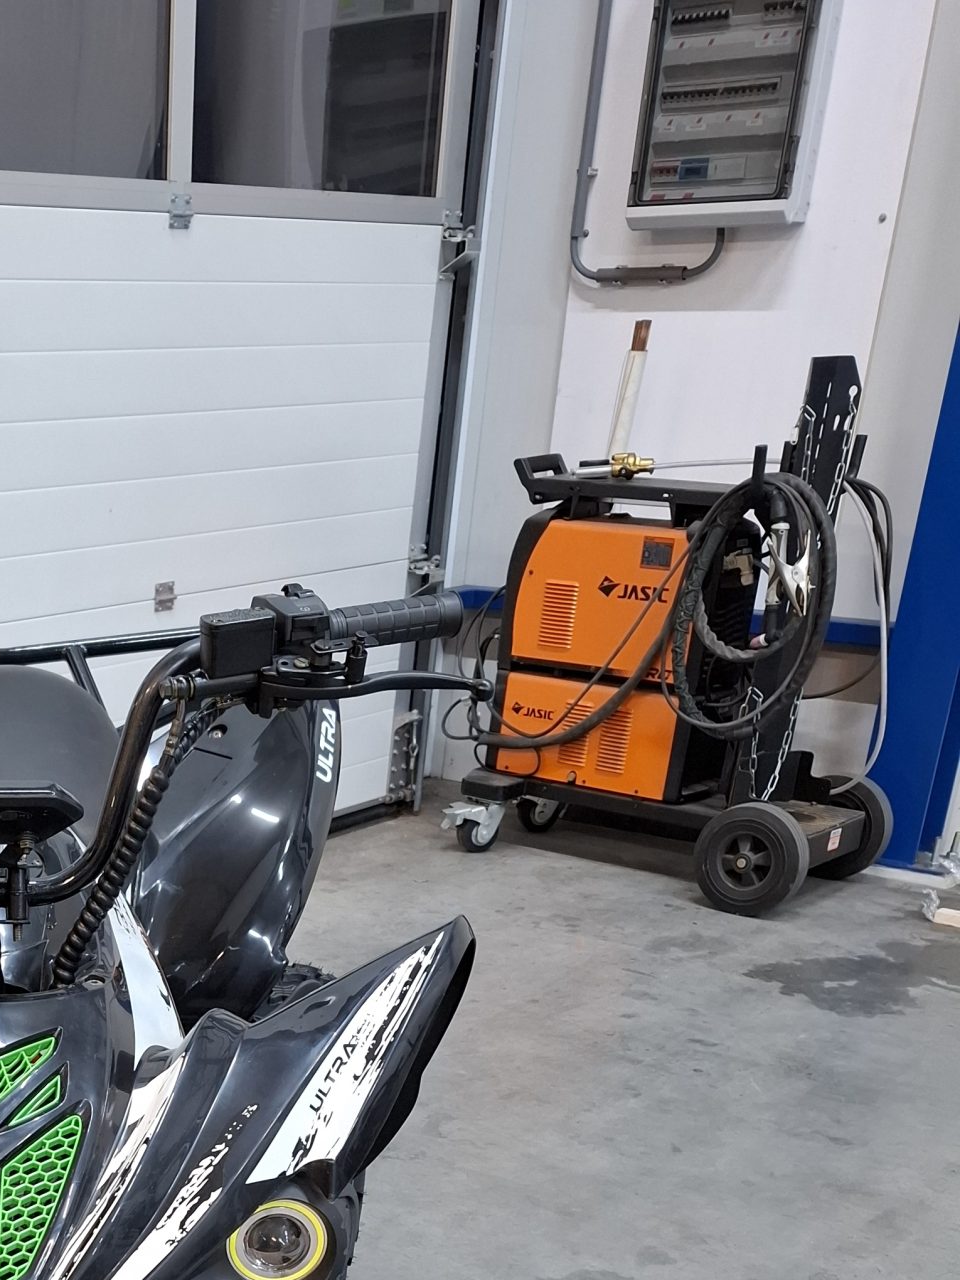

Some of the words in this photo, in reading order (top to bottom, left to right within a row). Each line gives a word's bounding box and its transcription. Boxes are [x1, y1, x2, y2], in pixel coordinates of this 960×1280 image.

[617, 584, 670, 604] JASIC
[523, 707, 555, 721] JASIC
[315, 707, 337, 783] ULTRA
[309, 1043, 358, 1112] ULTRA
